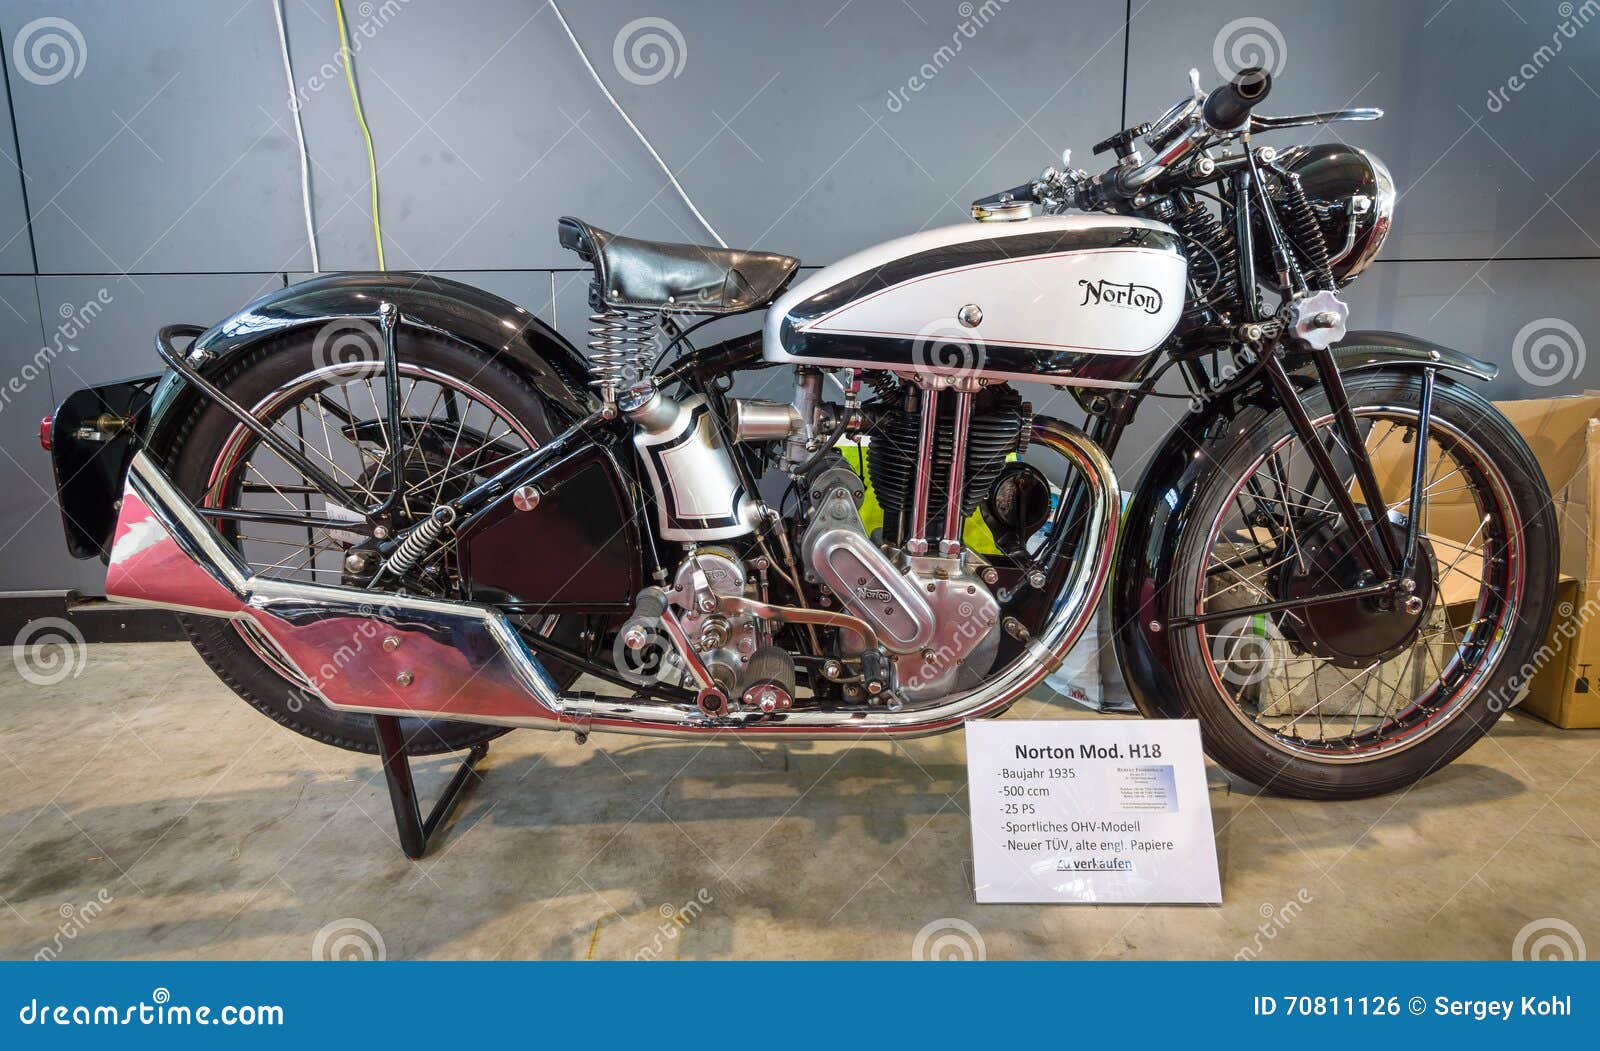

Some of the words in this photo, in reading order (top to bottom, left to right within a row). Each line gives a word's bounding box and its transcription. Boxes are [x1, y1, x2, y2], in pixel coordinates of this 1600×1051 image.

[1079, 279, 1163, 314] Norton
[857, 587, 892, 603] Norton
[1015, 744, 1075, 759] Norton
[1080, 744, 1124, 759] Mod.
[1129, 744, 1162, 759] H18
[1048, 768, 1076, 779] 1935
[1027, 788, 1050, 797] ccm
[1022, 803, 1035, 814] PS
[1071, 820, 1141, 833] OHV-Modell
[1045, 837, 1072, 853] TÜV,
[1075, 839, 1097, 851] alte
[1100, 840, 1127, 853] engl.
[1130, 840, 1174, 853] Papiere
[1074, 858, 1132, 870] verkaufen
